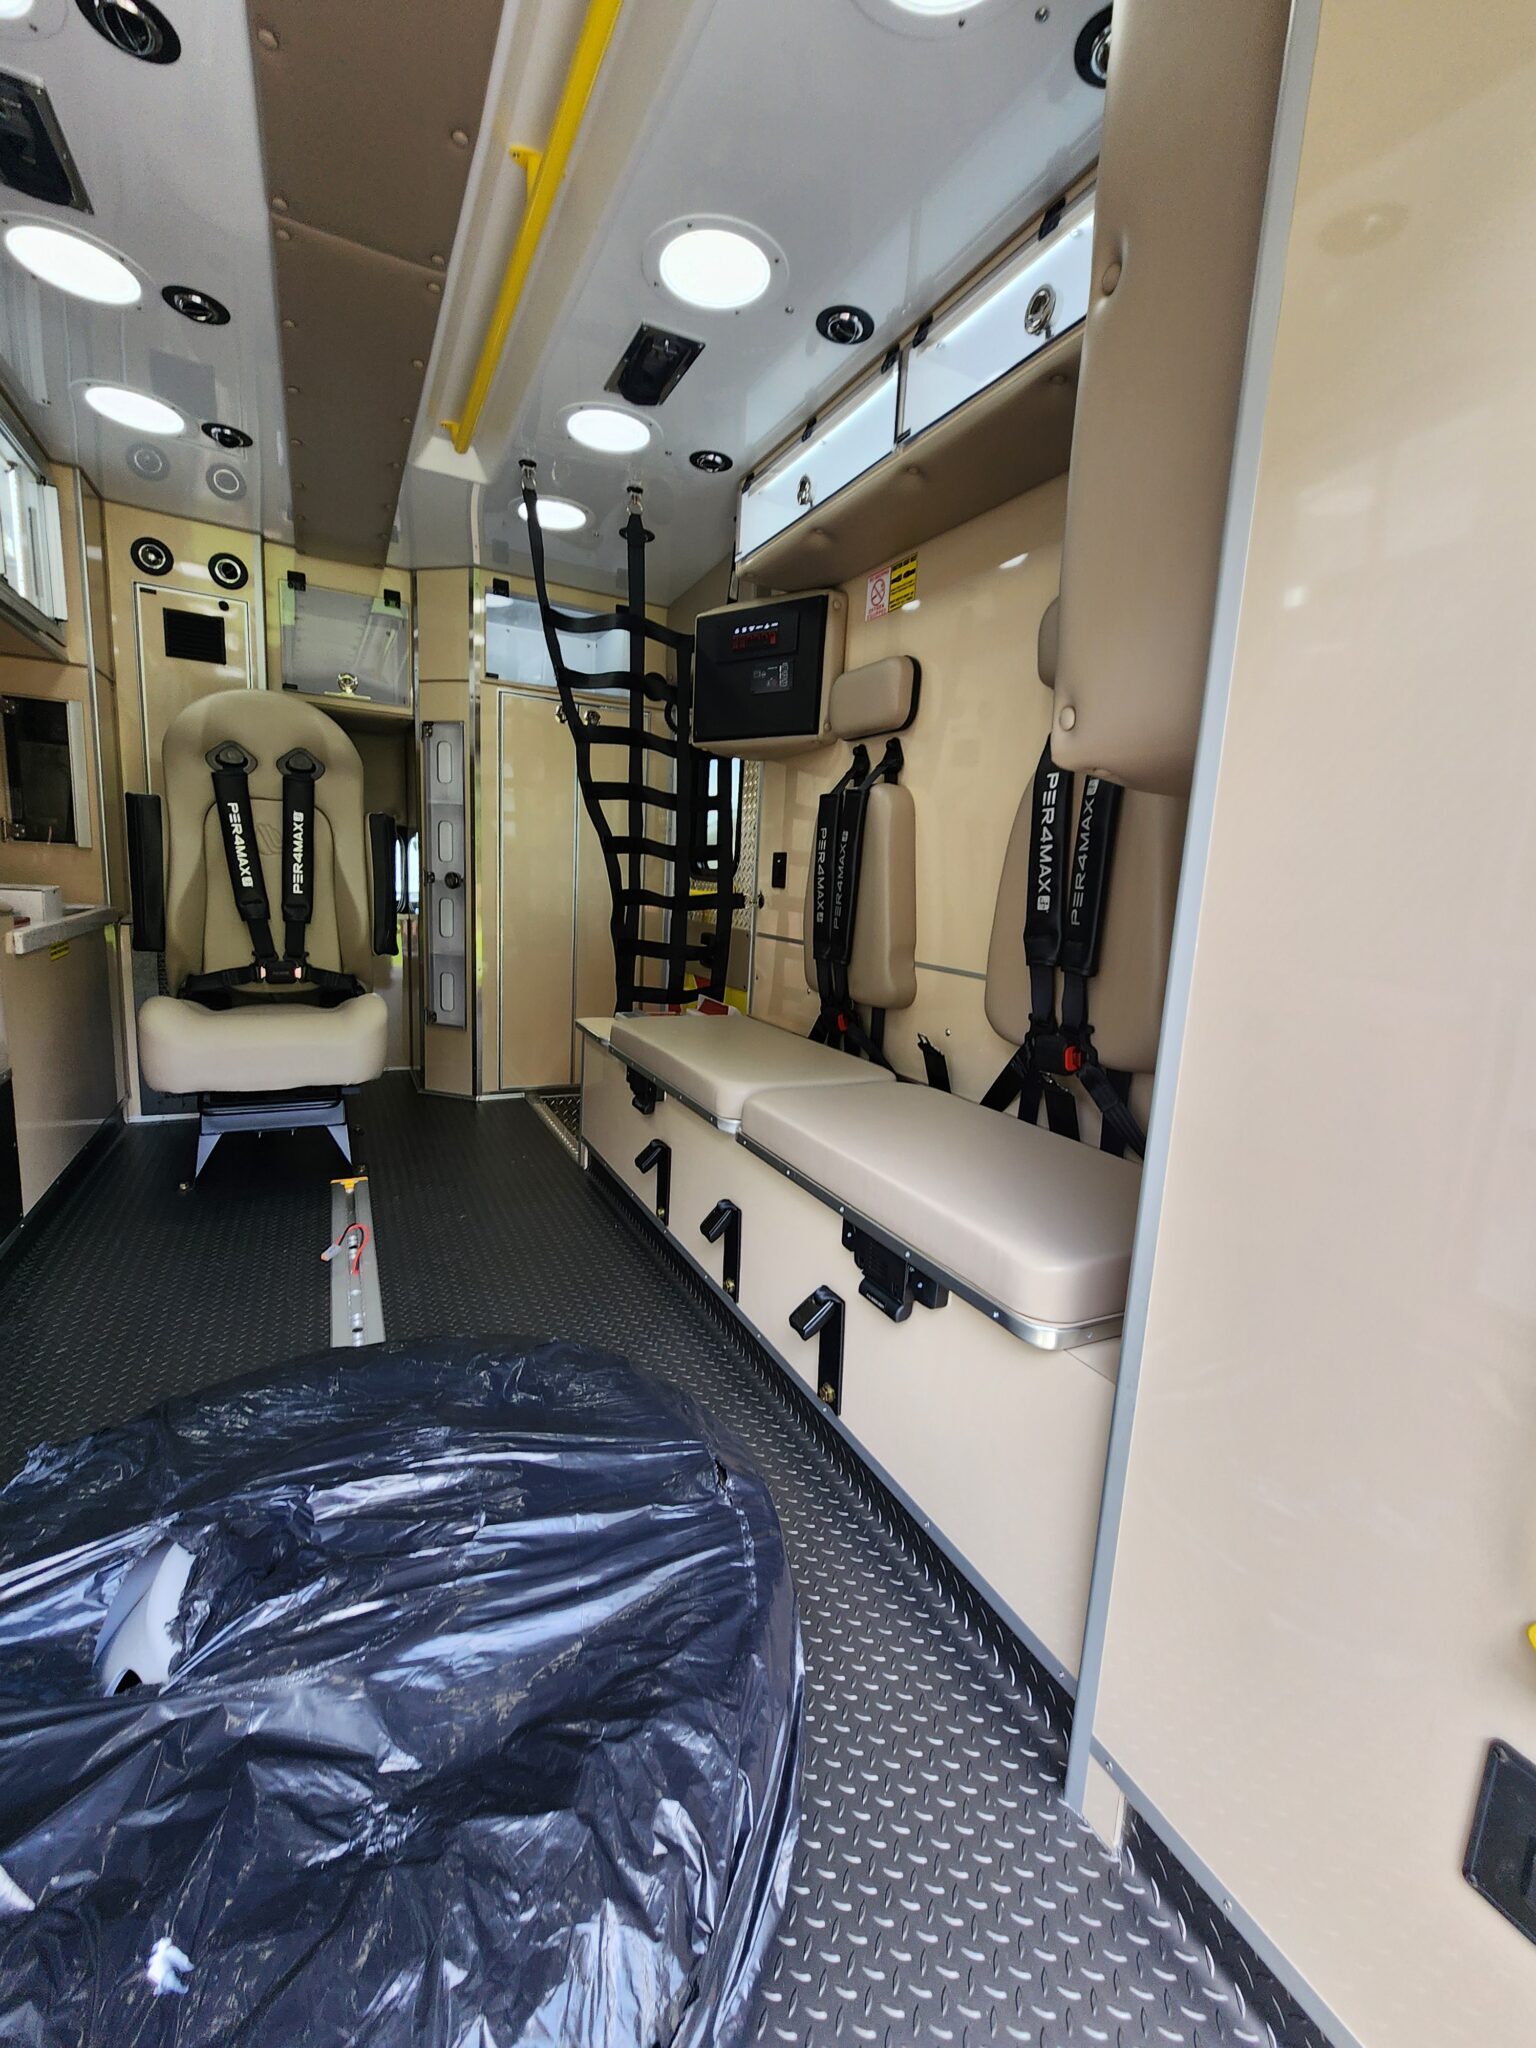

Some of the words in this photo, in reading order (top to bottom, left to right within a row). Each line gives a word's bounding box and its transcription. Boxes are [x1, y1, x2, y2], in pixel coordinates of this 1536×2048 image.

[227, 802, 251, 876] PER4MAX
[293, 822, 304, 894] PER4MAX
[817, 827, 827, 910] PER4MAX
[1038, 772, 1060, 893] PER4MAX
[1071, 798, 1095, 926] PER4MAX
[833, 844, 847, 929] PER4MAX
